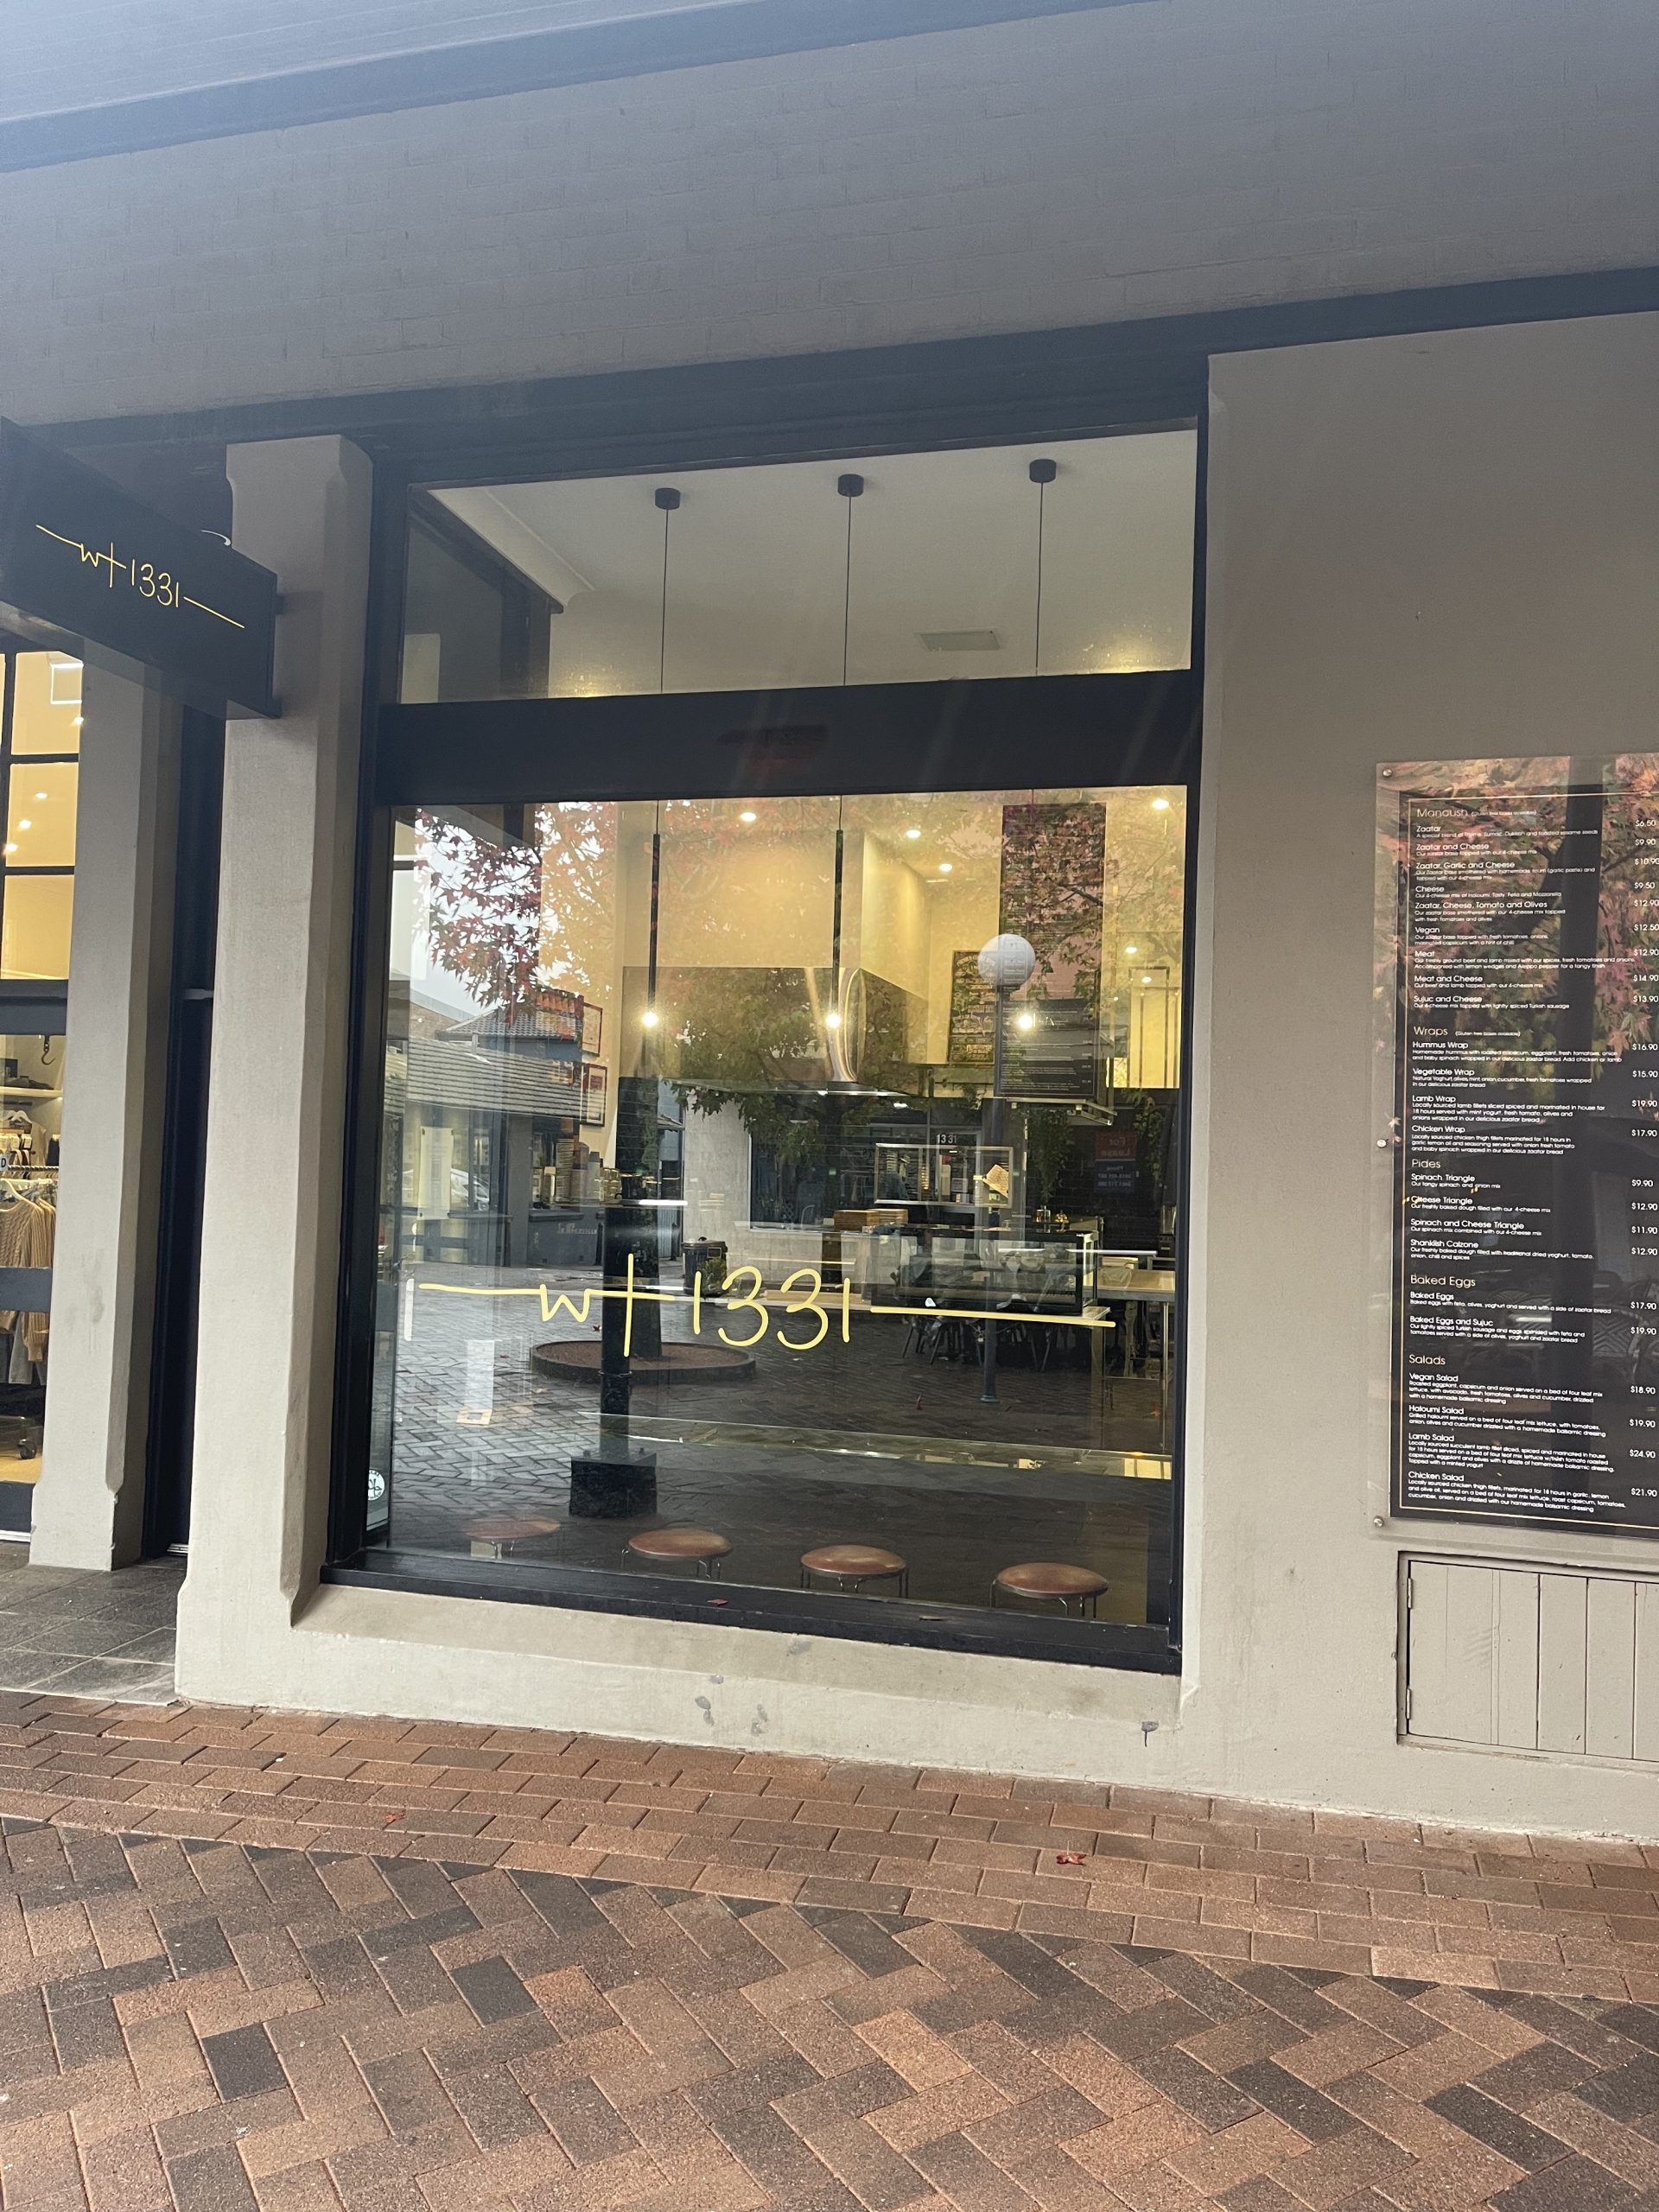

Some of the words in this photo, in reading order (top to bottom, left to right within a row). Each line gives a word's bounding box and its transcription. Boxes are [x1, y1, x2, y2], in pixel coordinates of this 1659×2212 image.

[1417, 808, 1468, 817] Manoush
[1413, 1026, 1448, 1036] Wraps
[1435, 1095, 1456, 1103] Wrap
[1445, 1125, 1465, 1134] Wrap
[1412, 1159, 1441, 1168] Pides
[1445, 1173, 1475, 1183] Triangle
[1410, 1195, 1441, 1204] Cheese
[1443, 1197, 1472, 1205] Triangle
[1631, 1202, 1658, 1211] $12.90
[1410, 1218, 1442, 1227] Spinach
[1461, 1219, 1491, 1228] Cheese
[1494, 1221, 1524, 1230] Triangle
[1410, 1238, 1445, 1247] Shanklish
[1446, 1240, 1479, 1249] Calzone
[1631, 1247, 1657, 1255] $12.90
[1410, 1274, 1446, 1286] Baked
[1449, 1276, 1476, 1288] Eggs
[1410, 1291, 1434, 1300] Baked
[1630, 1301, 1656, 1310] $17.90
[1410, 1315, 1434, 1324] Baked
[1435, 1316, 1454, 1325] Eggs
[1472, 1318, 1493, 1327] Sujuc
[1630, 1326, 1656, 1335] $19.90
[1408, 1354, 1446, 1365] Salads
[1409, 1372, 1434, 1382] Vegan
[1630, 1385, 1656, 1395] $18.90
[1408, 1405, 1440, 1414] Haloumi
[1441, 1406, 1464, 1414] Salad
[1629, 1418, 1656, 1427] $19.90
[1432, 1433, 1454, 1442] Salad
[1629, 1449, 1656, 1459] $24.90
[1408, 1471, 1440, 1479] Chicken
[1441, 1473, 1465, 1482] Salad
[1630, 1487, 1657, 1497] $21.90
